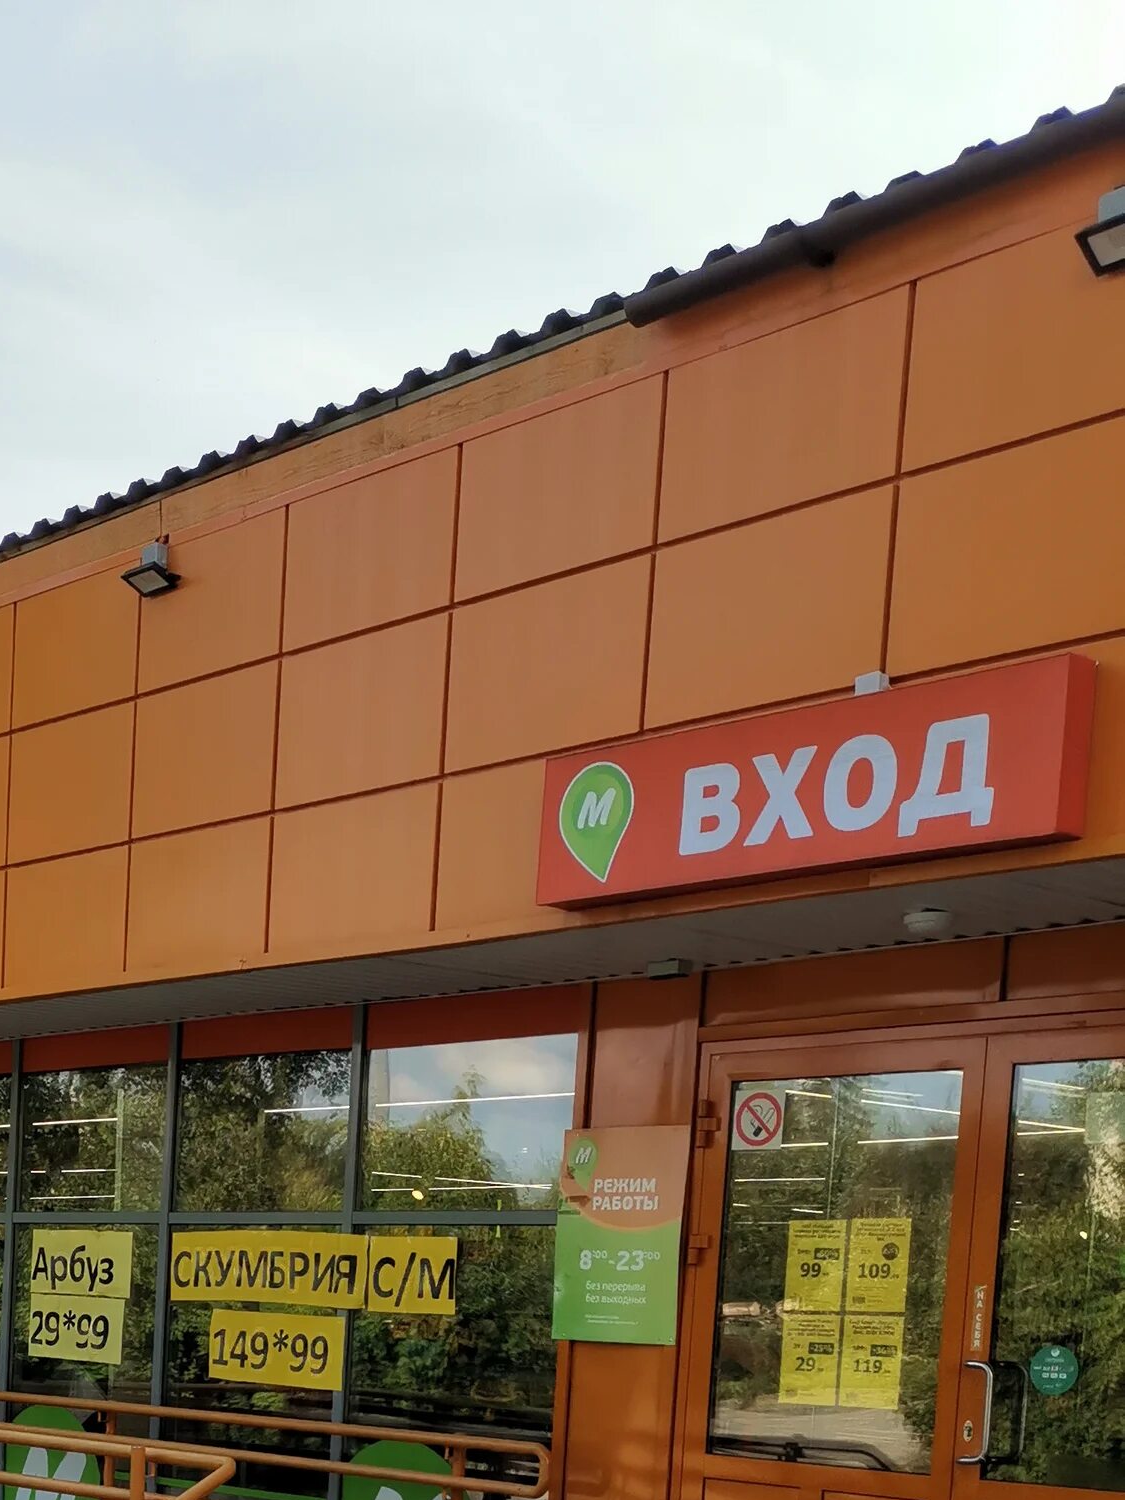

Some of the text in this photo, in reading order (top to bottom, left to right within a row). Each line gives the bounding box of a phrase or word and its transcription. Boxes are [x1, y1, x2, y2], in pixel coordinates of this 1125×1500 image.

[678, 712, 995, 856] ВХОД
[593, 1177, 657, 1194] РЕЖИМ
[592, 1195, 659, 1211] РАБОТЫ
[32, 1244, 114, 1292] Арбуз
[173, 1250, 456, 1307] СКУМБРИЯ С/М
[586, 1280, 601, 1291] без
[585, 1293, 647, 1306] без выходных
